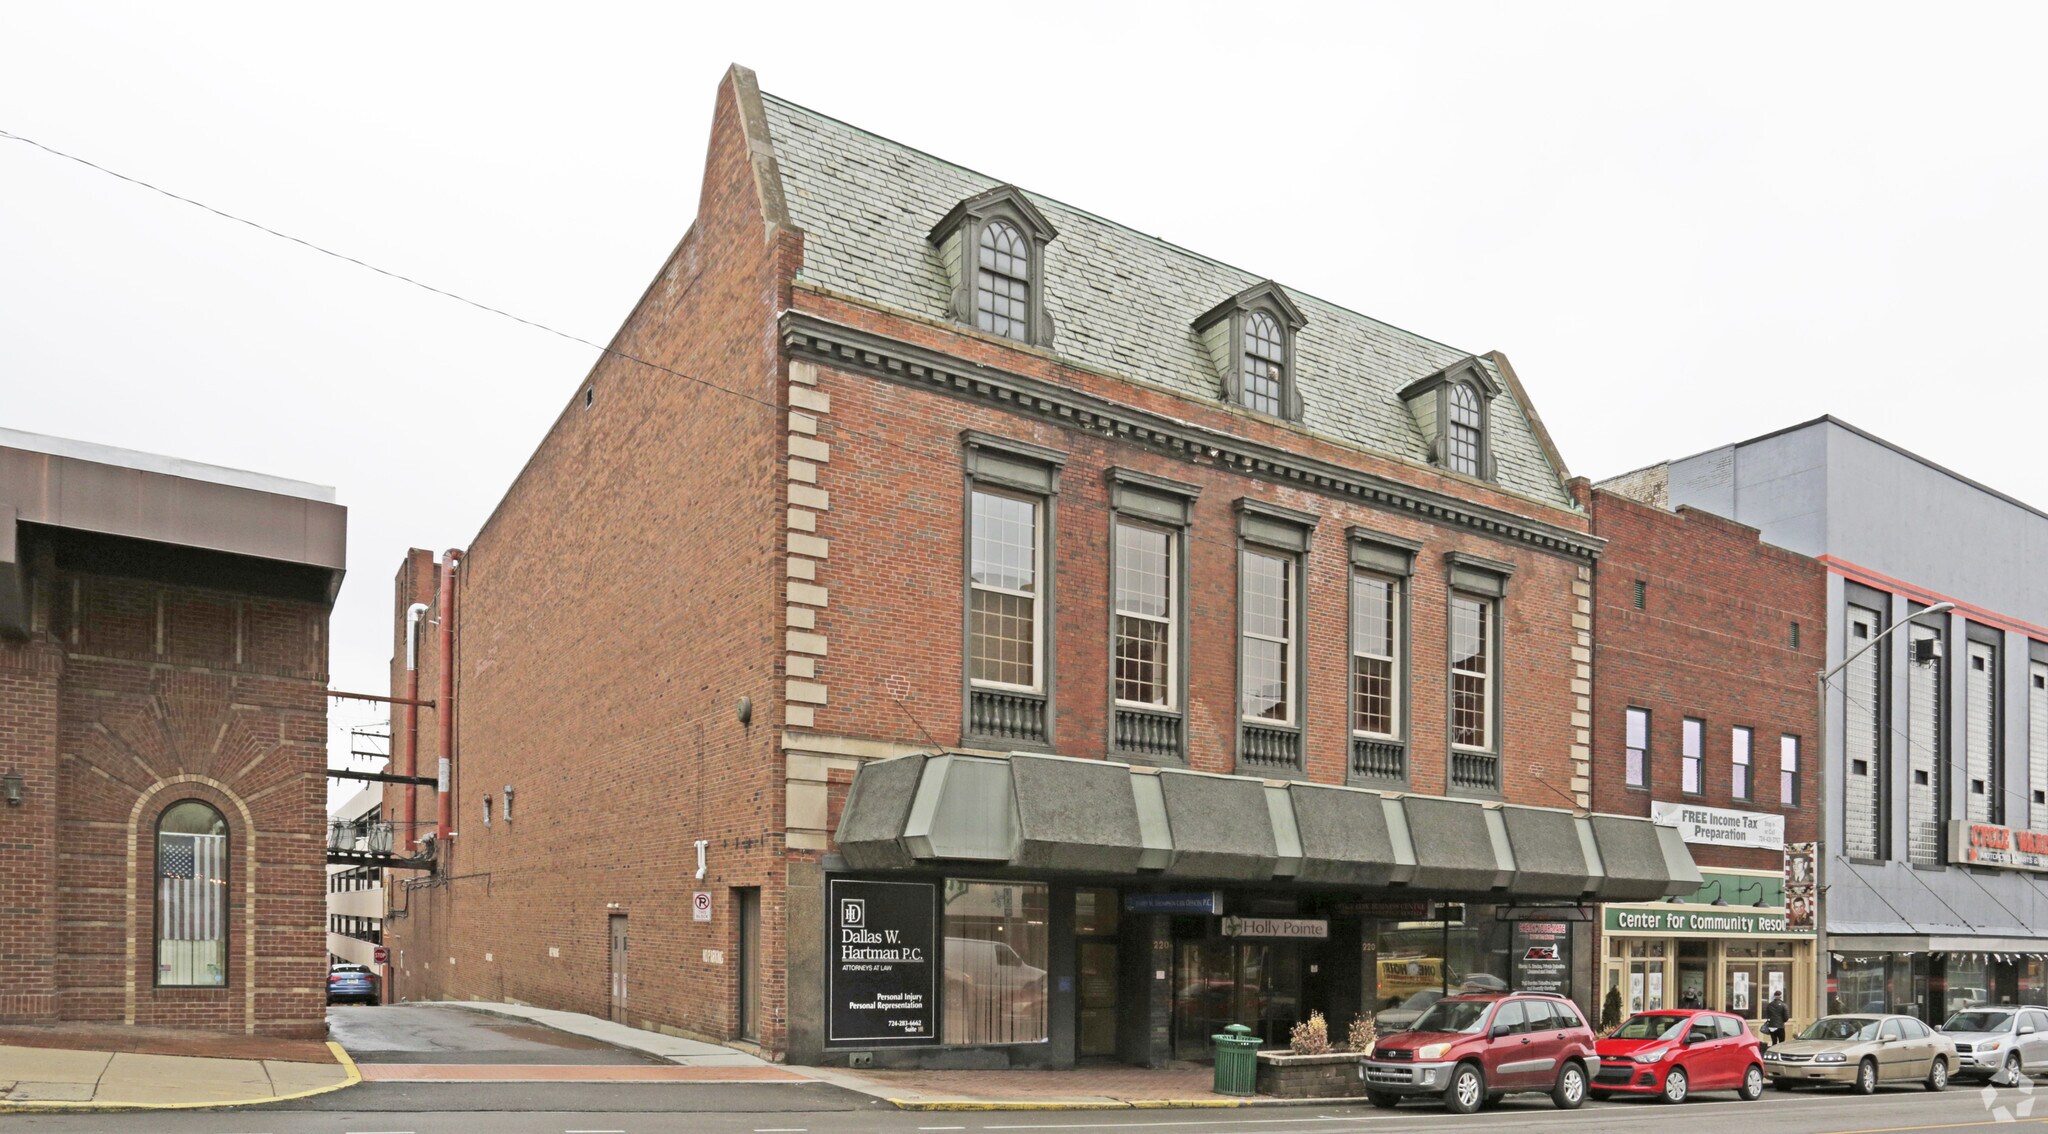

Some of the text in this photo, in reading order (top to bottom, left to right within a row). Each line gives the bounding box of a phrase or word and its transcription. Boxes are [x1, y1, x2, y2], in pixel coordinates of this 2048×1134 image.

[1682, 810, 1707, 824] FREE
[1709, 813, 1741, 827] Income
[1742, 816, 1758, 829] Tax
[1694, 825, 1746, 841] Preparation
[1971, 825, 2010, 850] CYCLE
[1244, 921, 1323, 935] Holly Pointe
[1618, 912, 1661, 928] Center
[1666, 913, 1685, 928] for
[1690, 914, 1753, 933] Community
[842, 929, 901, 944] Dallas W.
[842, 945, 923, 960] Hartman P.C.
[1153, 941, 1170, 950] 220
[904, 993, 922, 1002] Injury
[849, 1001, 922, 1011] Personal Representation
